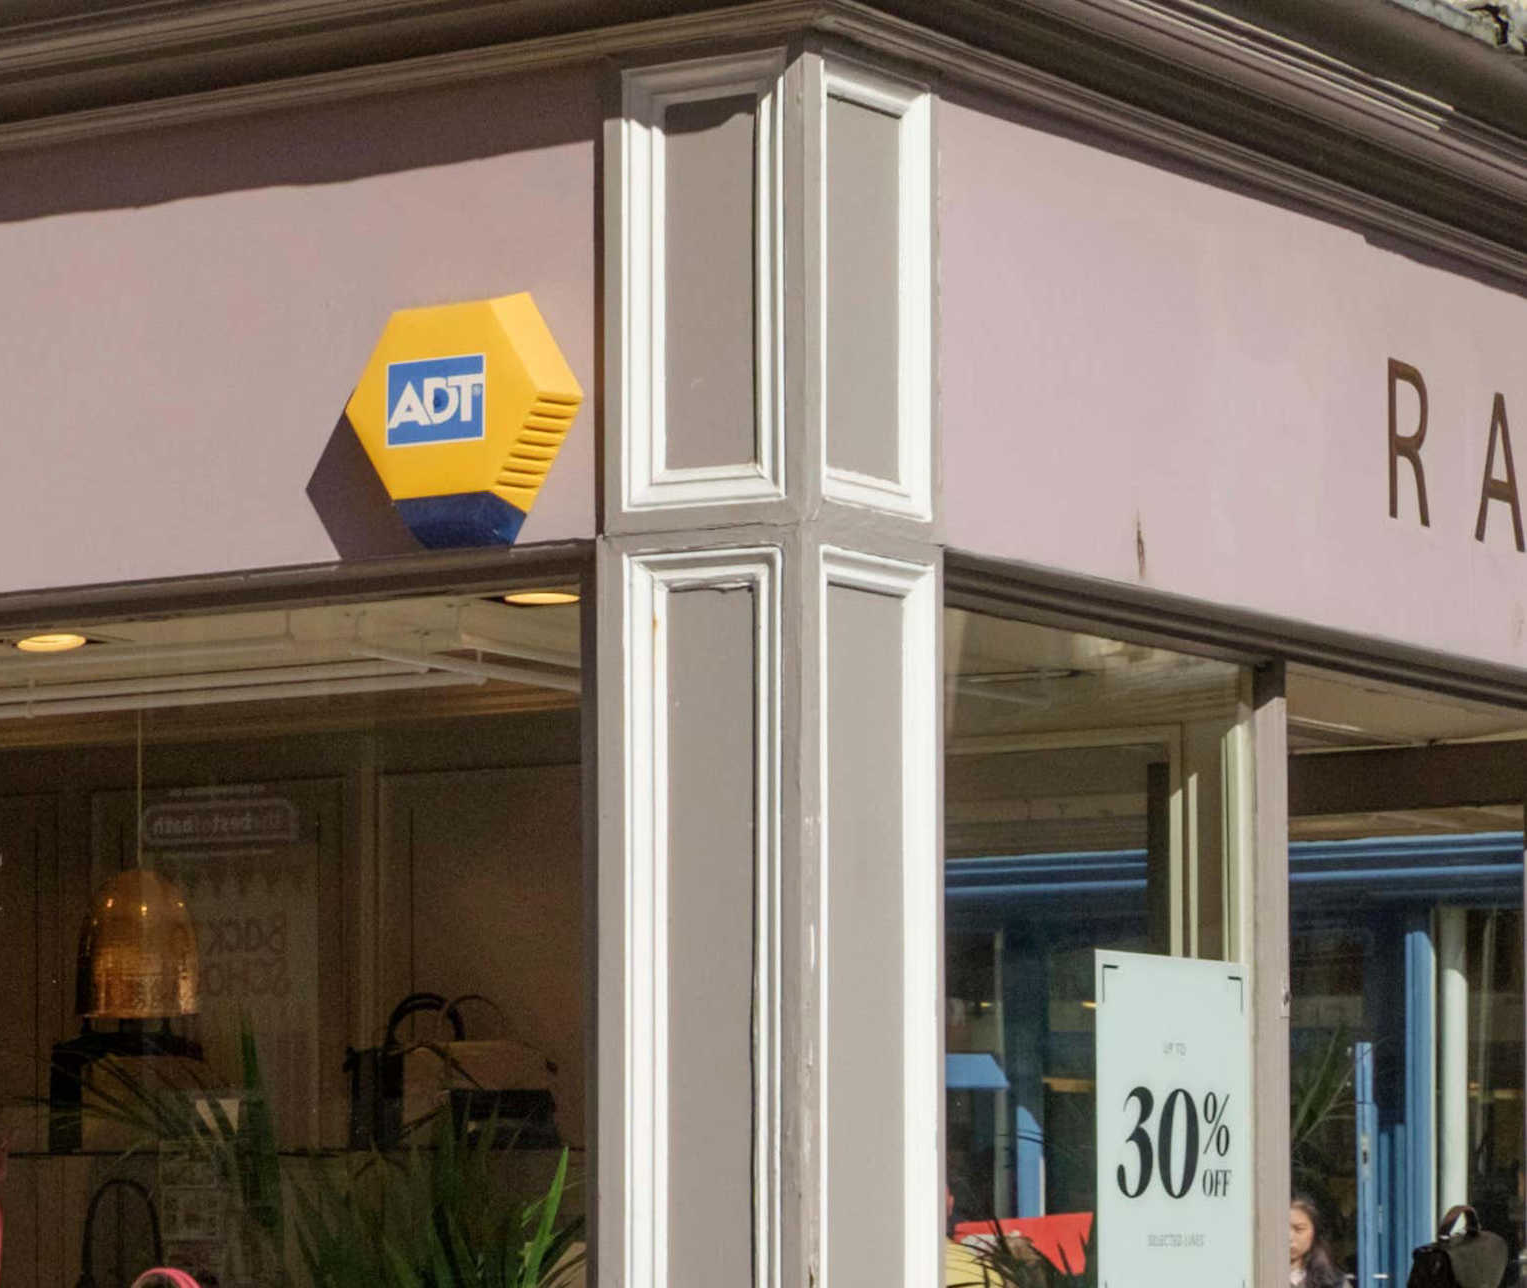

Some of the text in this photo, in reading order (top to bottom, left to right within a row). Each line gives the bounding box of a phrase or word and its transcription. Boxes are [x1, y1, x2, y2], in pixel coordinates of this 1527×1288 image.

[387, 373, 484, 429] ADT
[1387, 357, 1526, 553] RA
[1117, 1086, 1230, 1198] 30%
[1202, 1168, 1231, 1197] OFF
